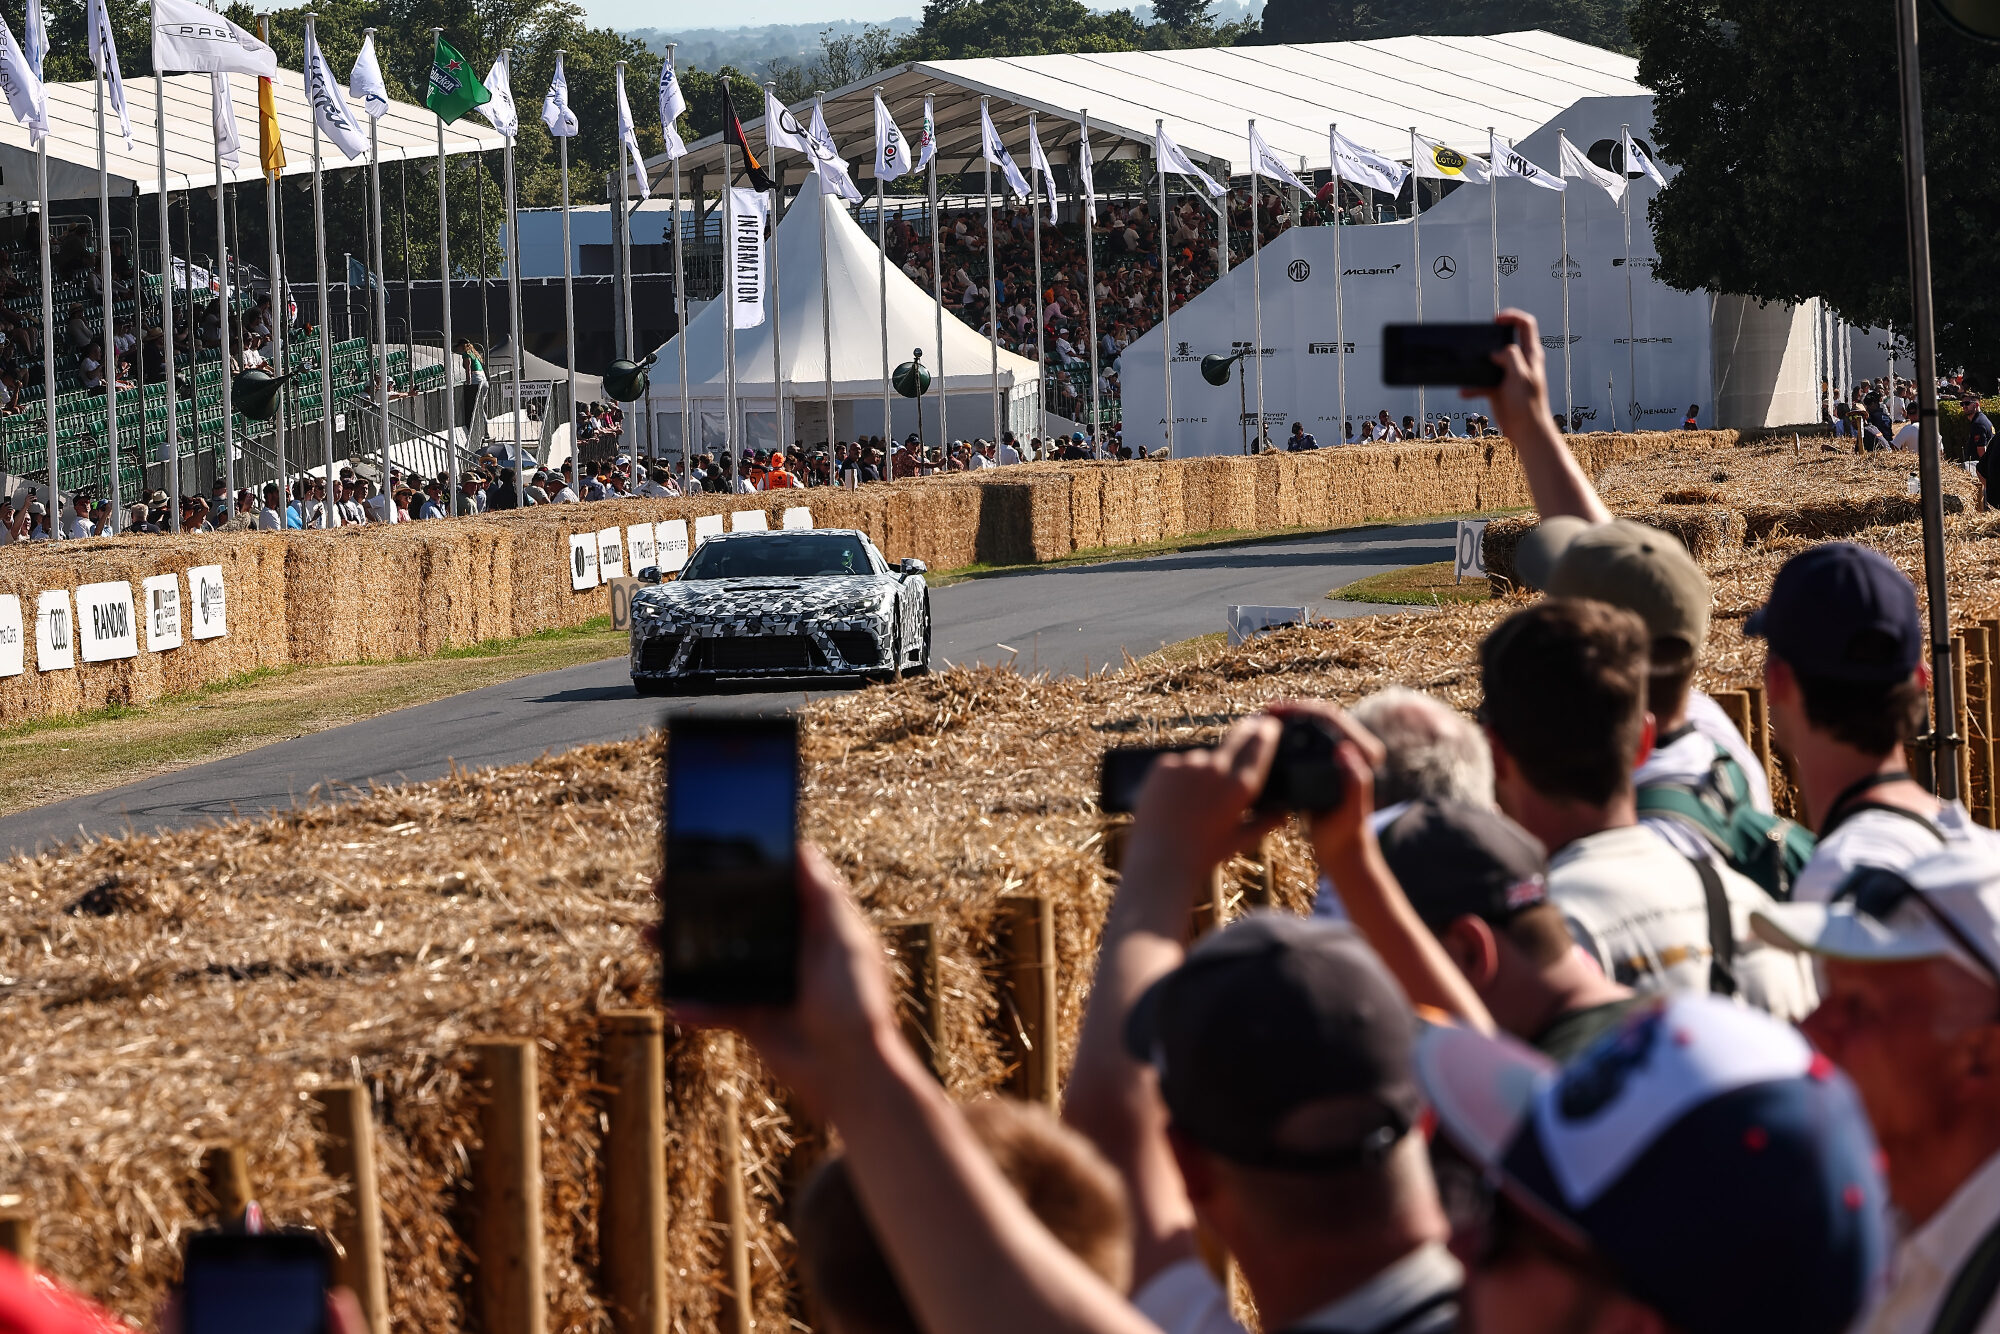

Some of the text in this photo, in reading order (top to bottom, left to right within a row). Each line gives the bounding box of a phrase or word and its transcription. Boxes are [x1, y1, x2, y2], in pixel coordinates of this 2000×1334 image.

[1437, 156, 1463, 166] LOTUS
[737, 214, 759, 303] INFORMATION
[1498, 256, 1517, 264] TAG
[1342, 266, 1396, 276] McLaren
[1309, 342, 1355, 355] PIRELI
[602, 544, 622, 565] HONDA
[92, 601, 130, 641] RANDOX
